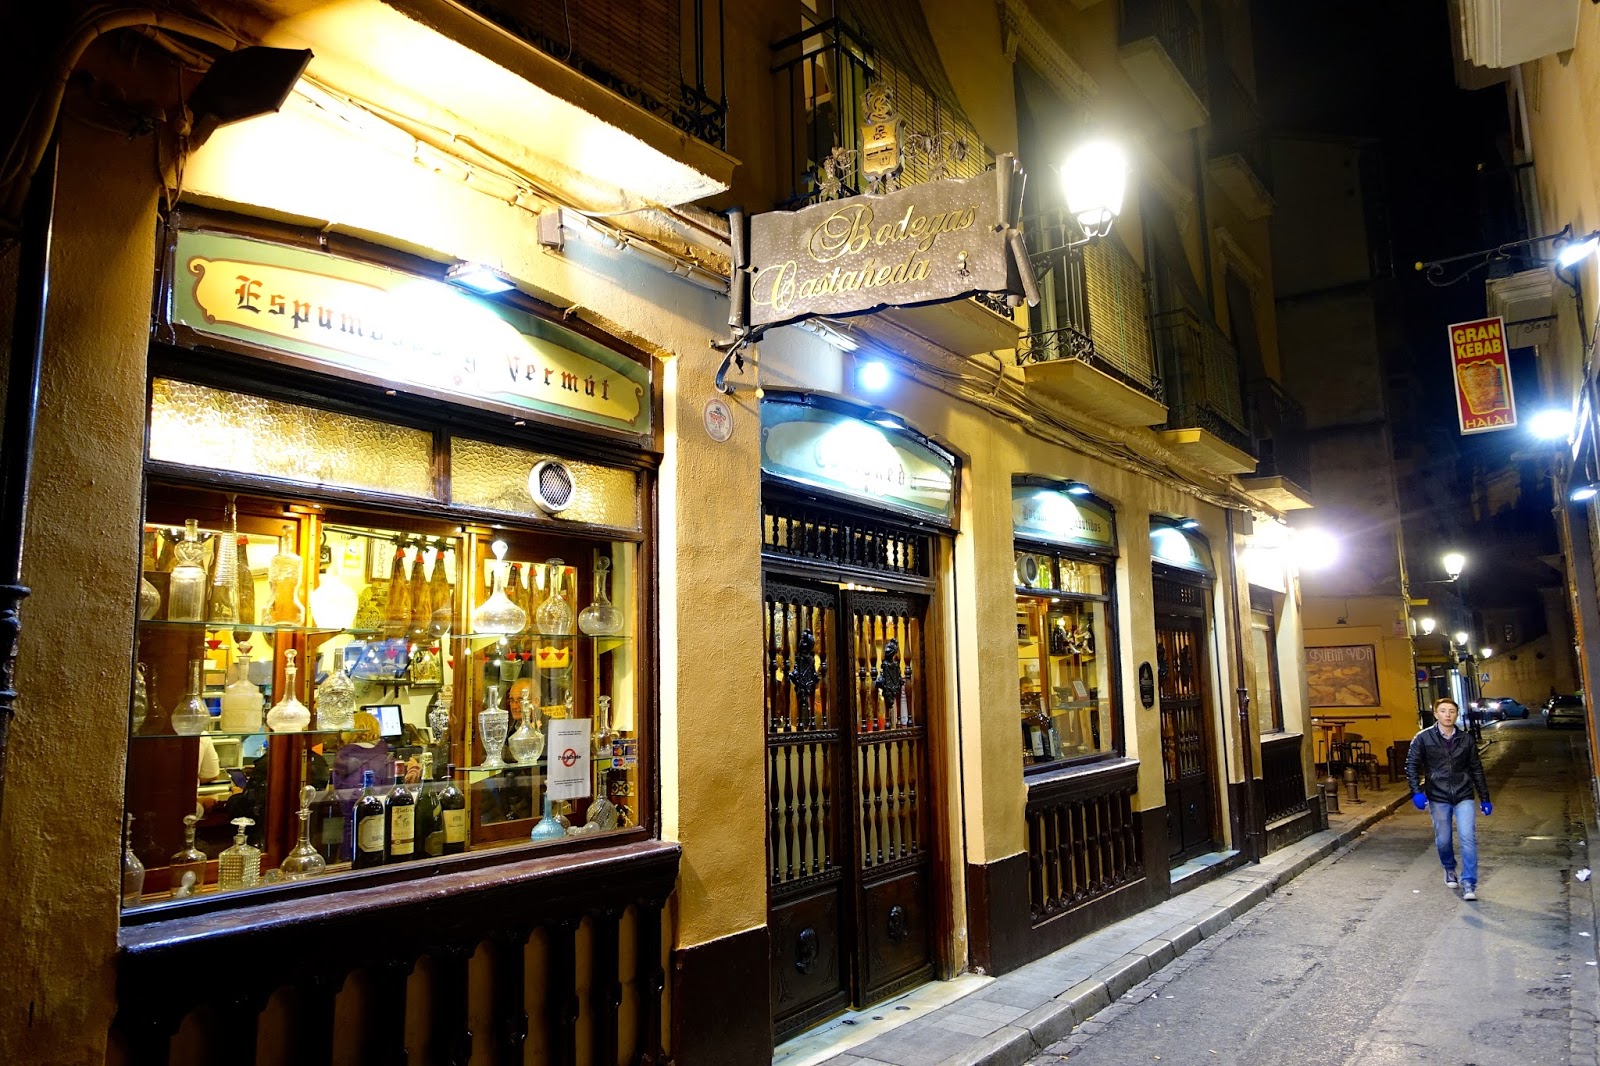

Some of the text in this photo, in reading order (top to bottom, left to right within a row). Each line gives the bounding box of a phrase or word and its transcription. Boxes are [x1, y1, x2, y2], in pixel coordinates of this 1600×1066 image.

[808, 203, 979, 263] Bodegas
[751, 251, 933, 311] Castañeda
[1453, 324, 1501, 345] GRAN
[1456, 339, 1503, 359] KEBAB
[505, 351, 610, 400] Vermút
[1465, 414, 1511, 429] HALAL
[1309, 649, 1344, 664] BUENA
[1346, 648, 1374, 661] VIDA
